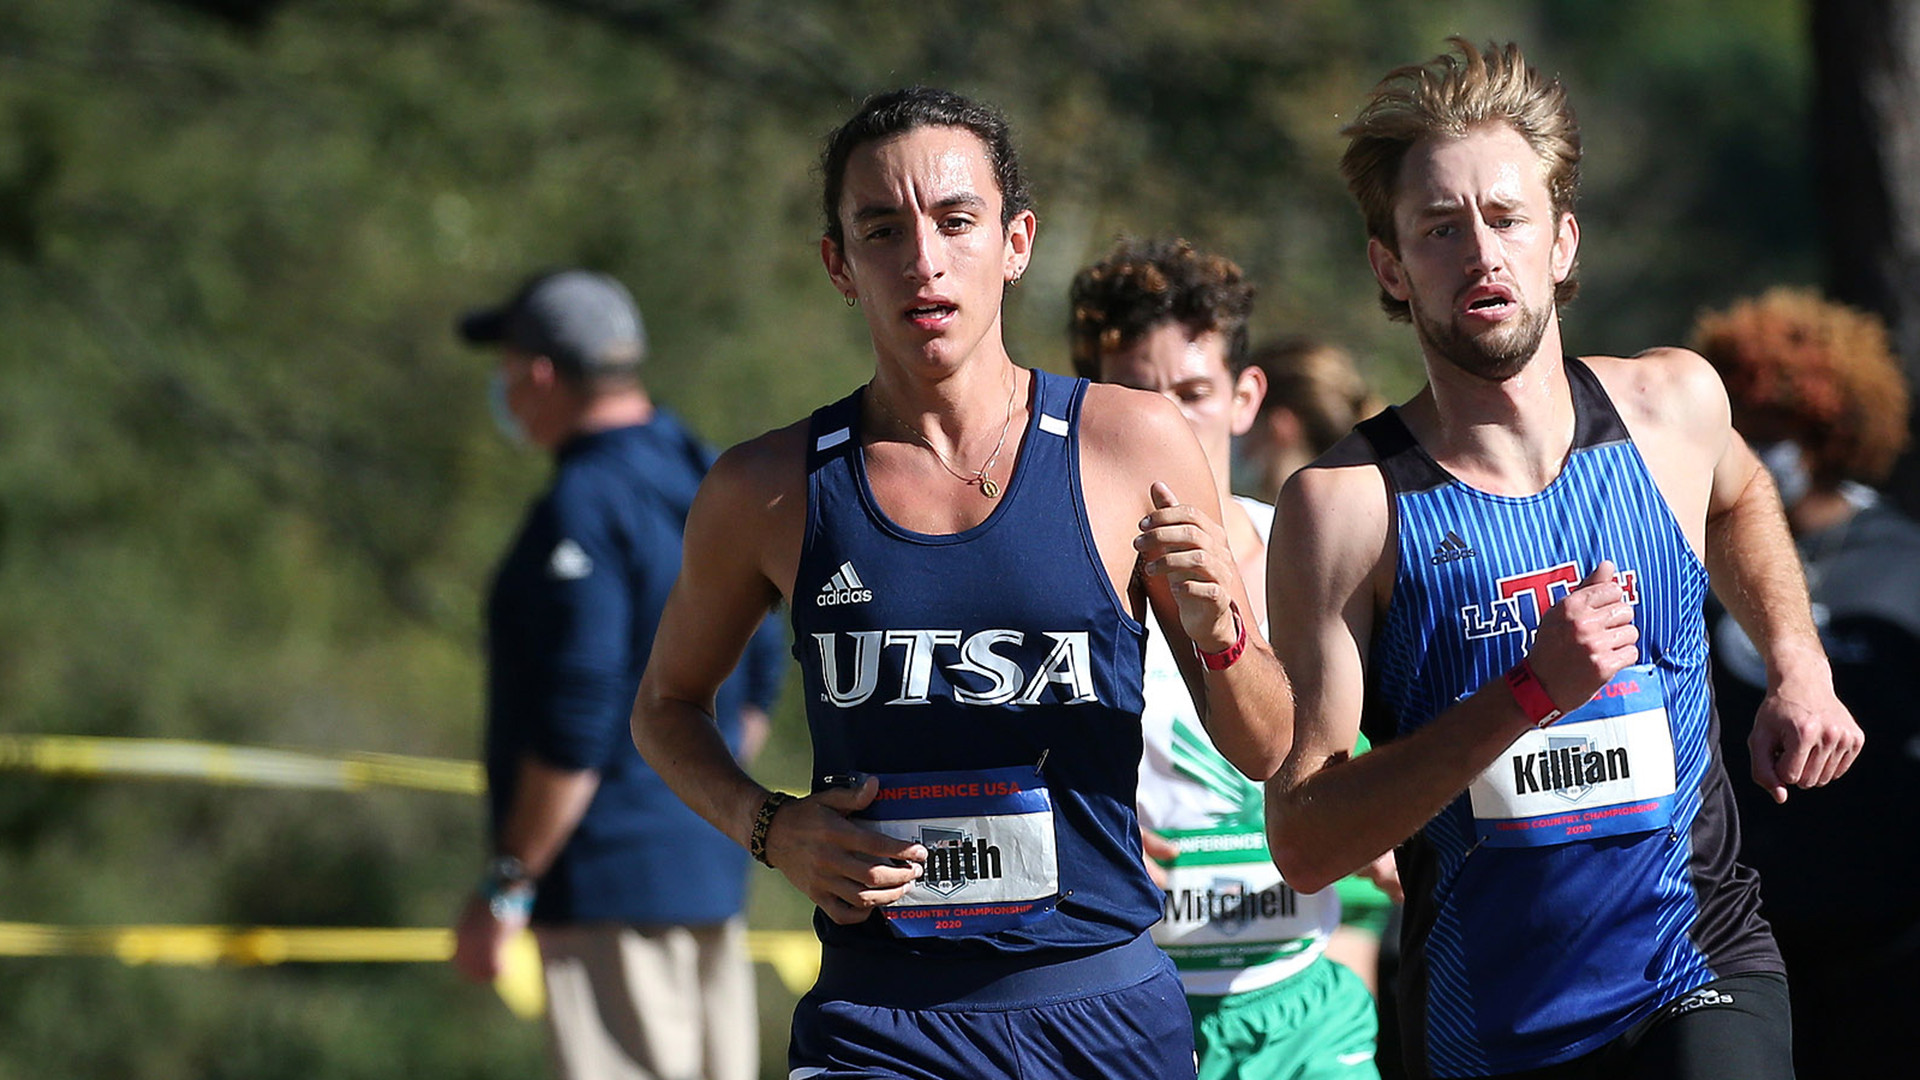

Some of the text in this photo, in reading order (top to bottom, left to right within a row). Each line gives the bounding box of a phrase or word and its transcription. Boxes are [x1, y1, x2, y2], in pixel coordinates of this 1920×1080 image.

[1431, 548, 1476, 566] adidas
[816, 588, 872, 606] adidas
[1461, 600, 1524, 640] LA
[810, 629, 1098, 708] UTSA
[1605, 680, 1640, 698] USA
[1512, 746, 1630, 795] Killian
[876, 781, 1022, 800] ONFERENCE USA
[1531, 814, 1580, 829] COUNTRY
[1583, 802, 1660, 820] CHAMPIONSHIP
[1565, 824, 1592, 836] 2020
[915, 837, 1003, 882] mith
[900, 908, 950, 919] COUNTRY
[953, 904, 1033, 917] CHAMPIONSHIP
[1164, 880, 1295, 924] Mitchell
[935, 920, 962, 930] 2020
